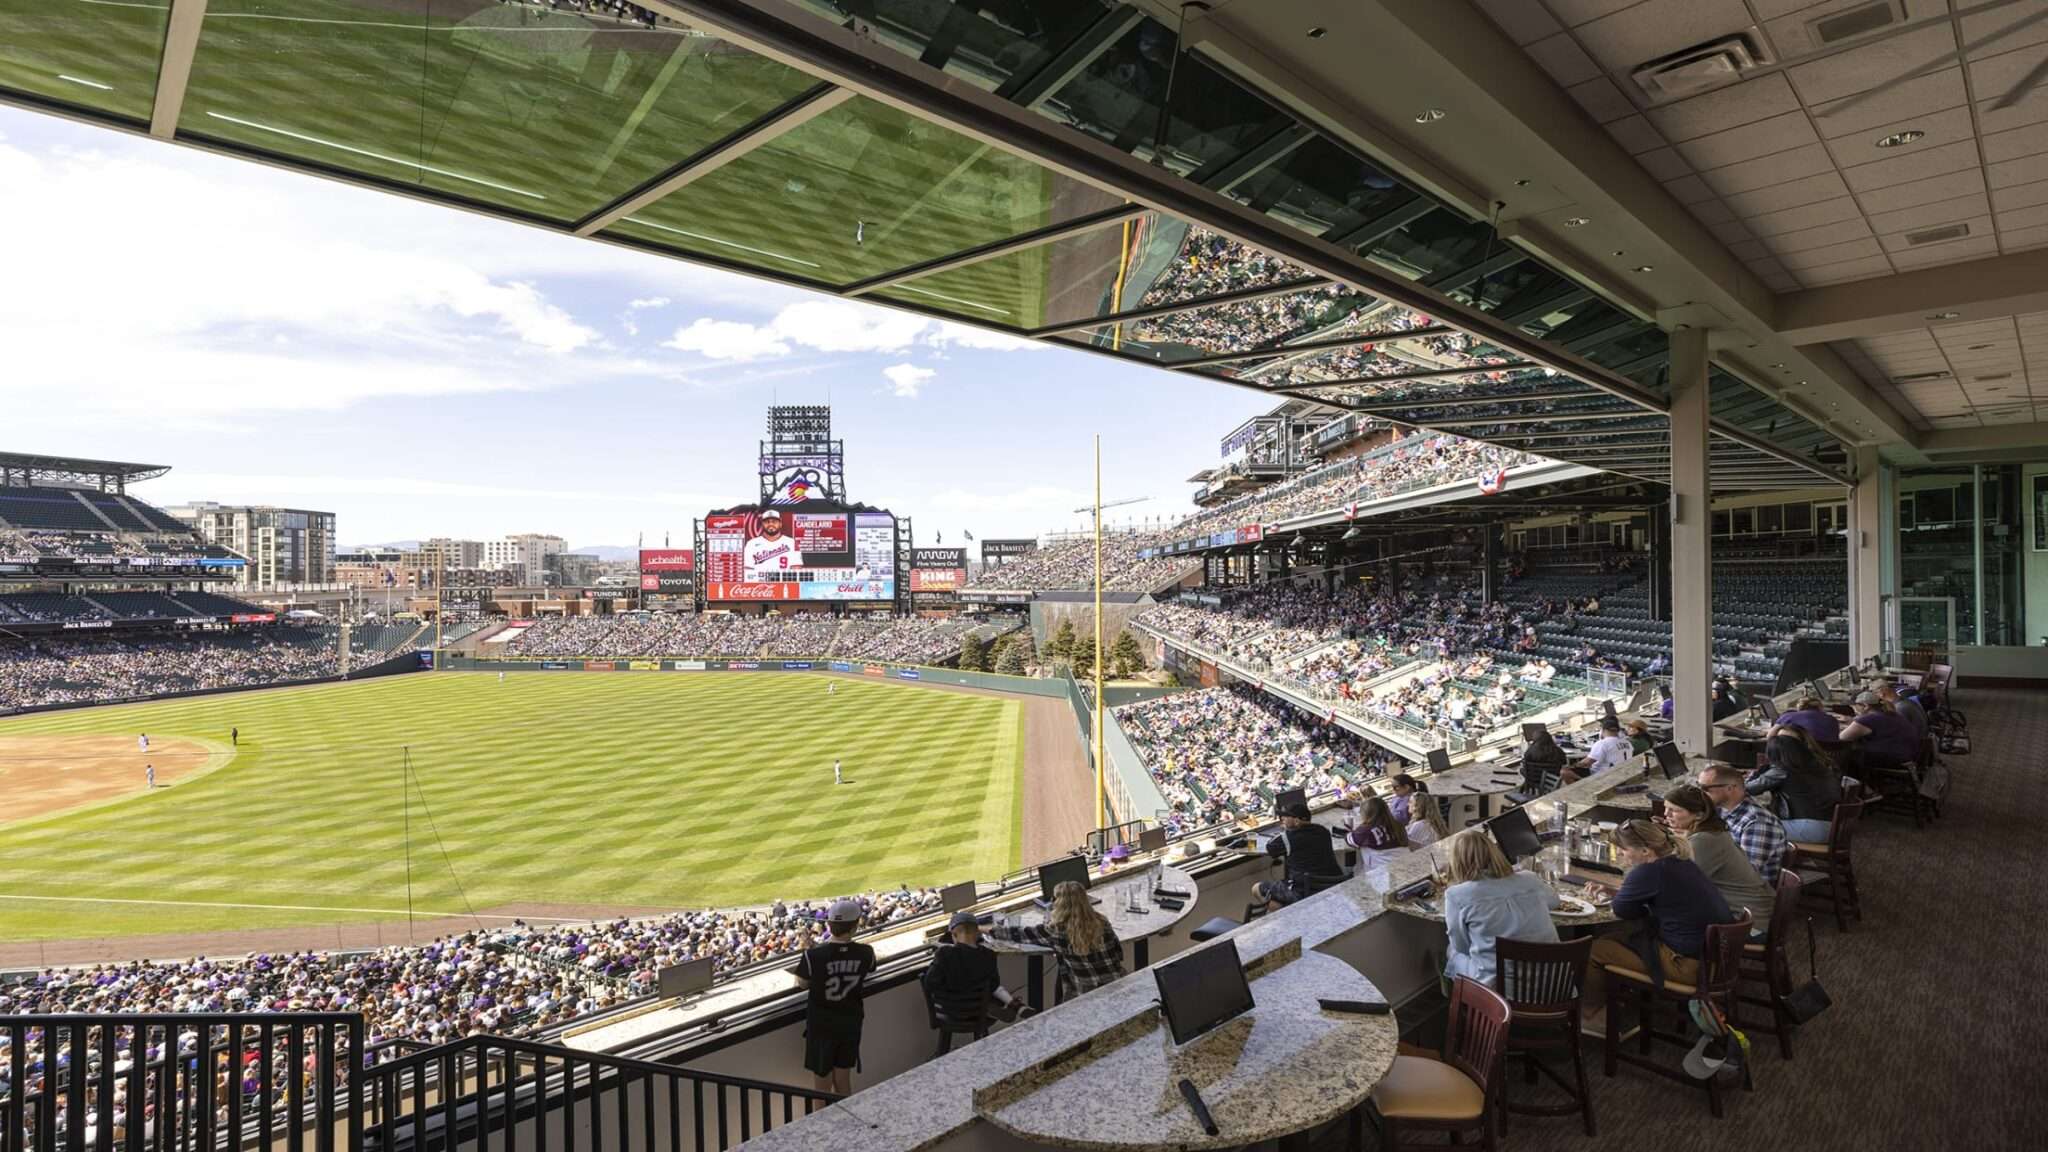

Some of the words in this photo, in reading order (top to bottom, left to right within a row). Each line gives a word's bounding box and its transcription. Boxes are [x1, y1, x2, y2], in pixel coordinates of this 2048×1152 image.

[779, 556, 788, 569] 9
[920, 571, 955, 581] KING
[838, 583, 864, 593] Chill
[825, 975, 861, 1001] 27
